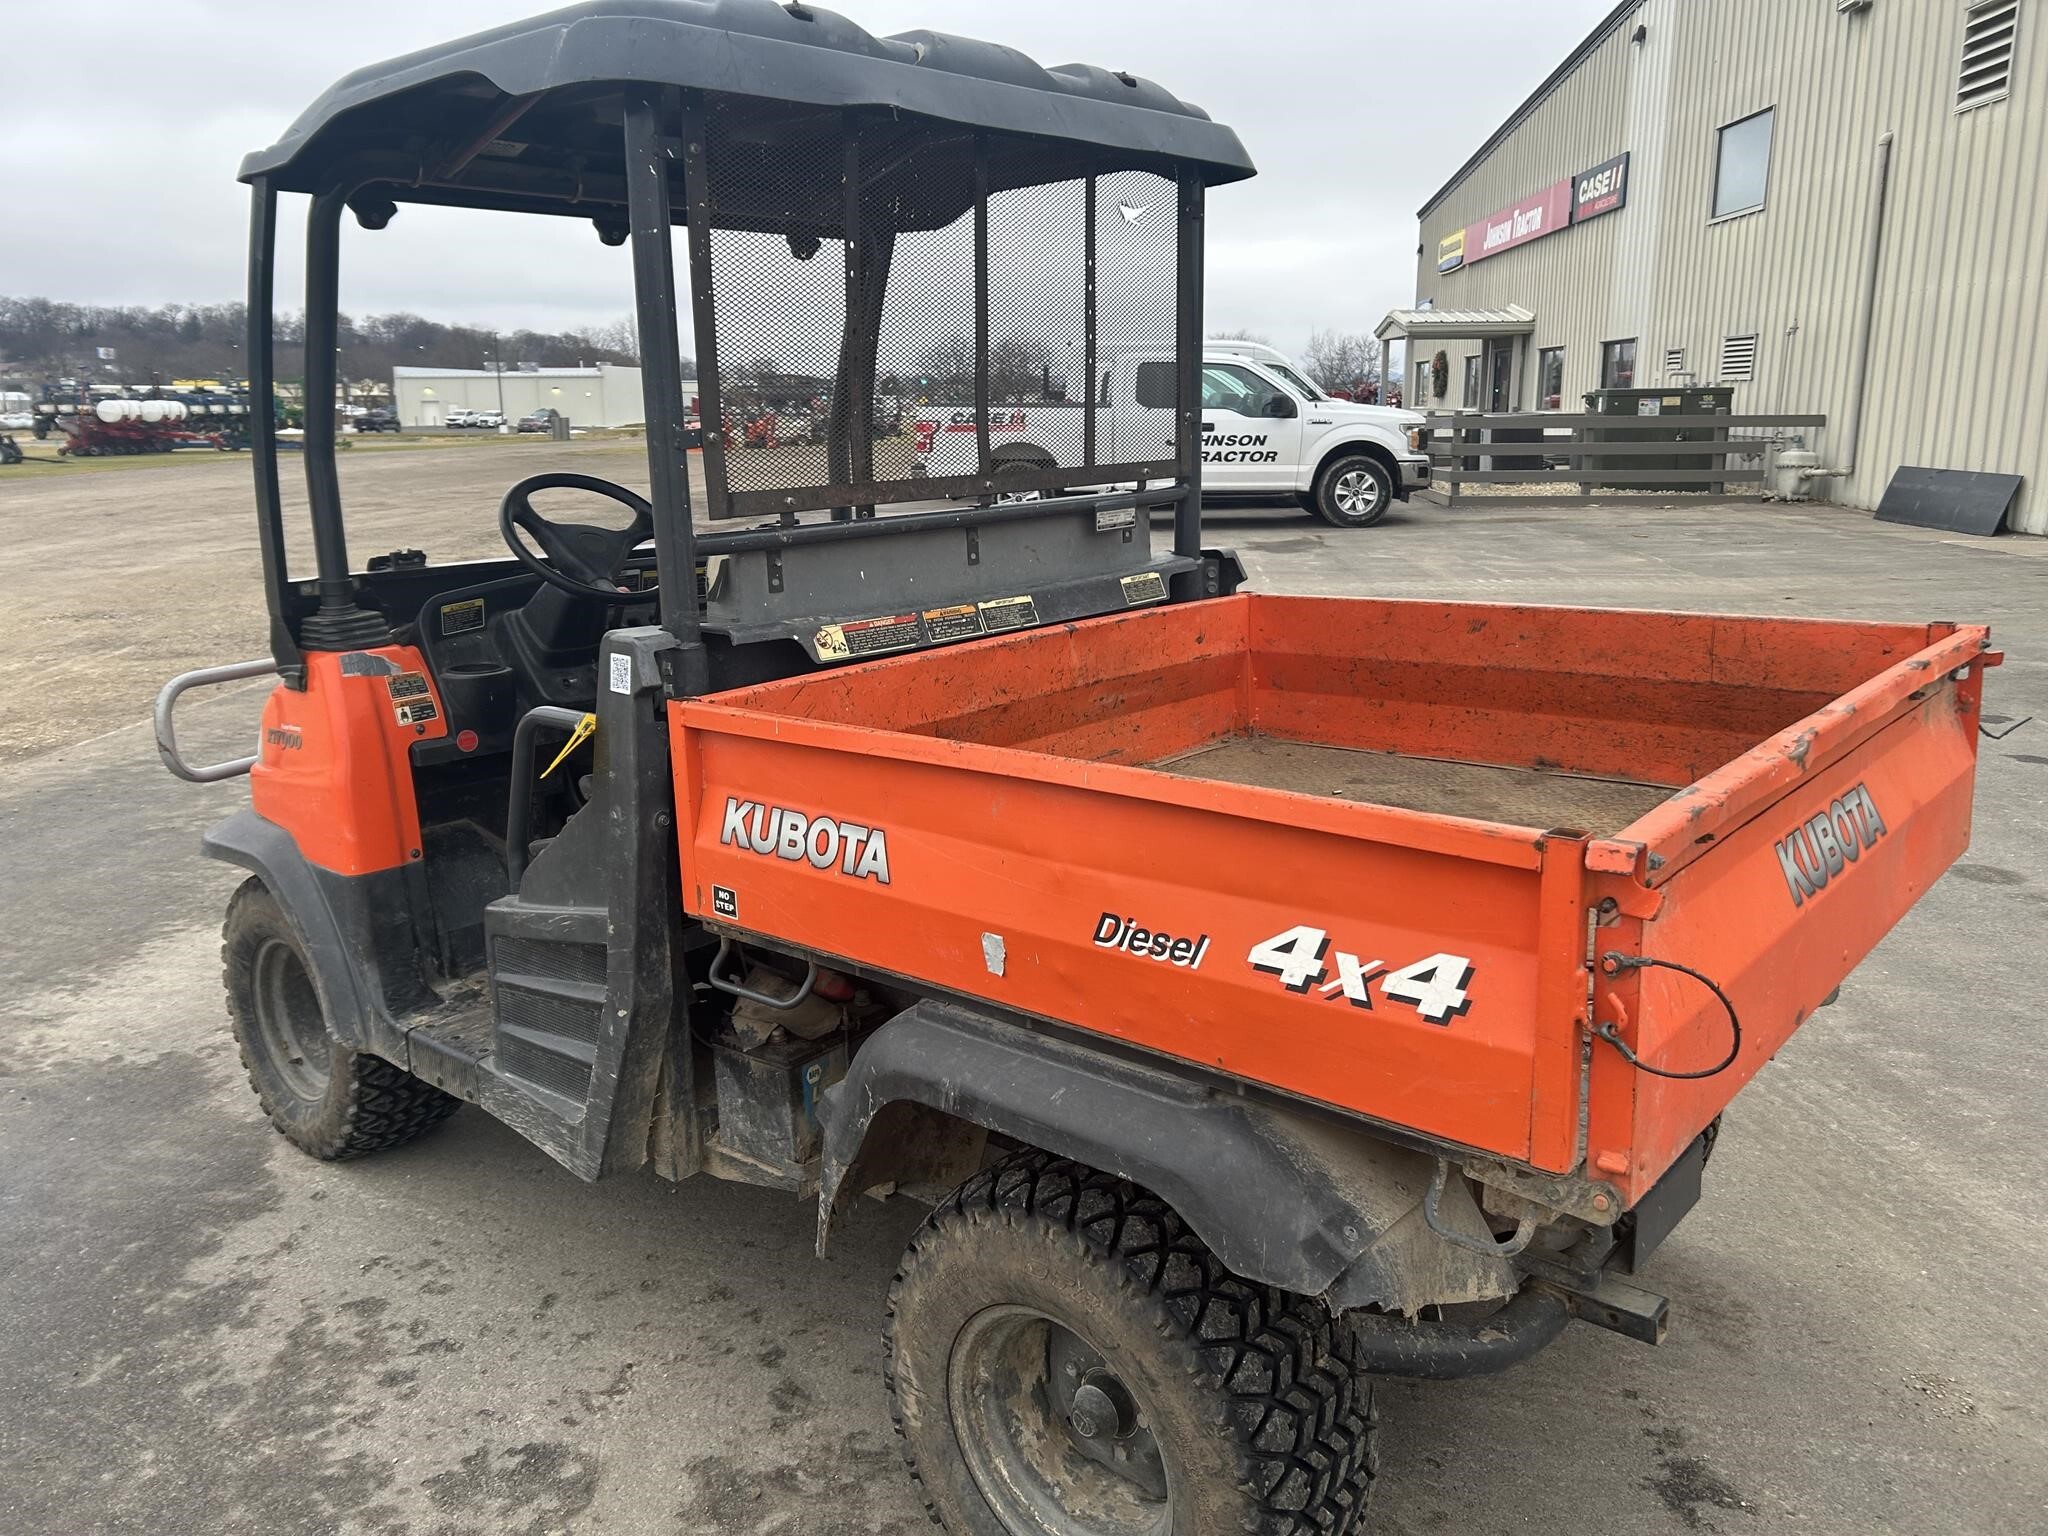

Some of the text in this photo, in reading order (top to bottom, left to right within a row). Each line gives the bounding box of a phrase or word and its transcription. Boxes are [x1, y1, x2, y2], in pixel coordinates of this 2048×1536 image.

[1579, 169, 1611, 203] CASE
[874, 619, 896, 627] DANGER
[720, 797, 890, 884] KUBOTA
[1774, 782, 1887, 908] KUBOTA
[715, 900, 735, 911] STEP
[718, 890, 730, 900] NO
[1092, 912, 1211, 969] Diesel
